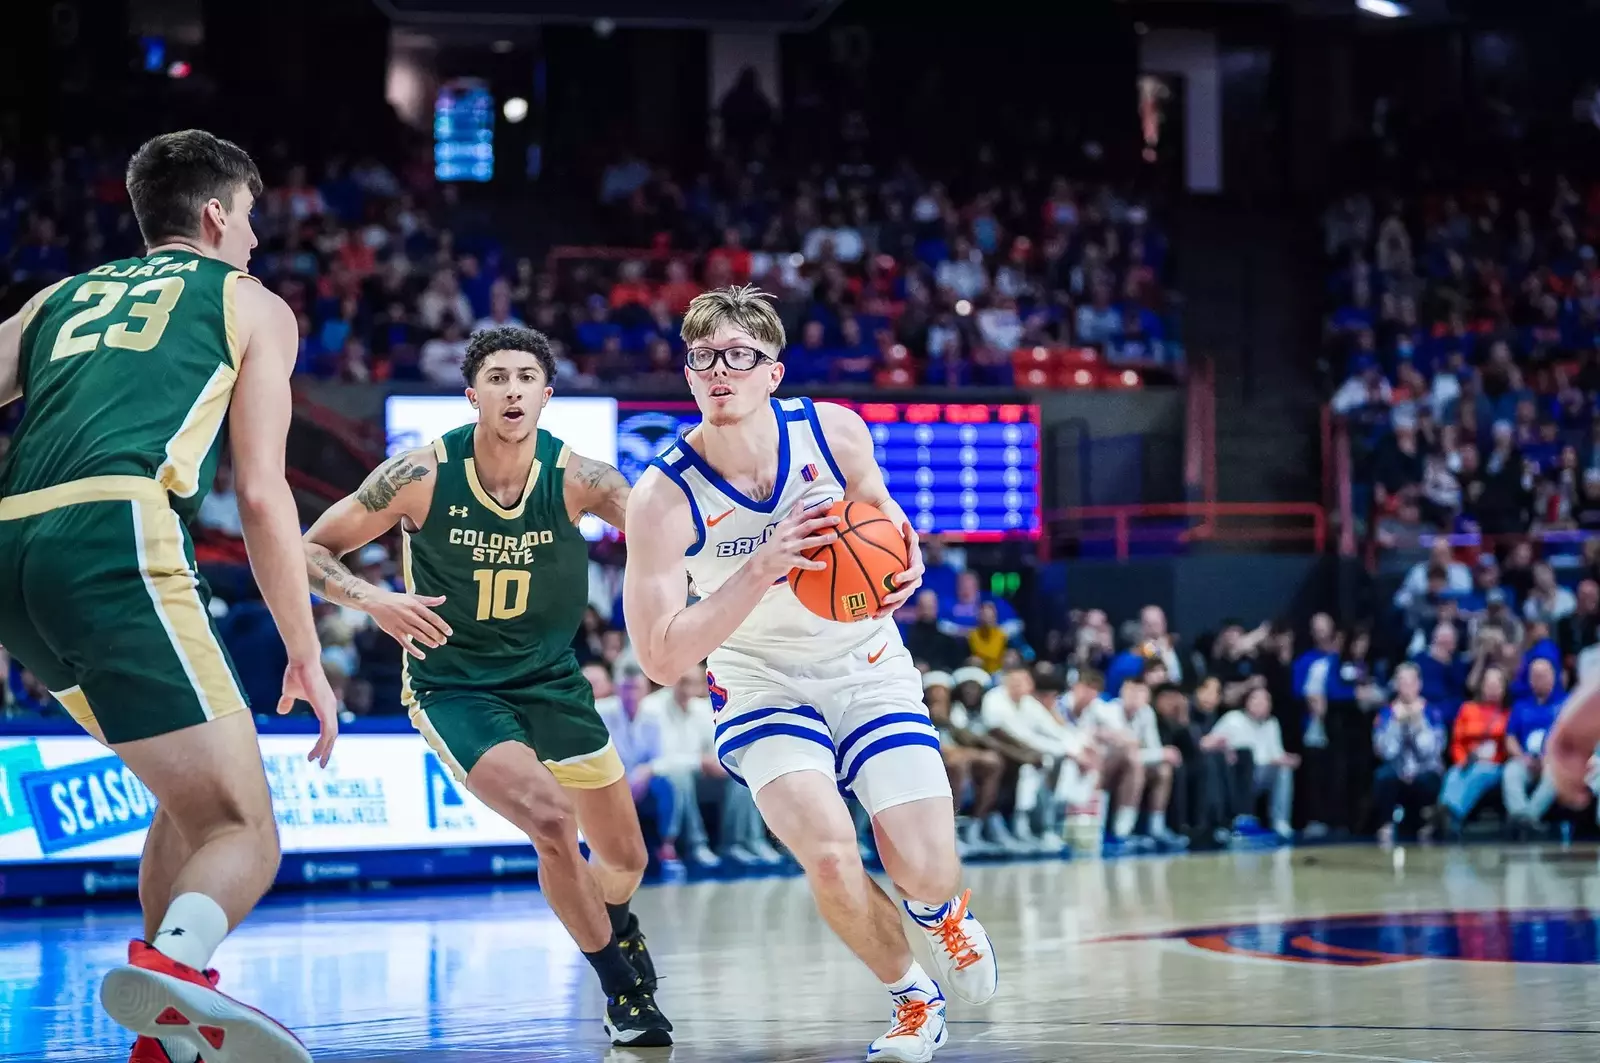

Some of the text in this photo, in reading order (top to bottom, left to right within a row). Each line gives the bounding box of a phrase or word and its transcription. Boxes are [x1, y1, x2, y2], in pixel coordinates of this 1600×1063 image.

[88, 260, 199, 278] DJAPA
[50, 276, 185, 362] 23
[449, 528, 553, 551] COLORADO
[472, 547, 534, 565] STATE
[473, 569, 531, 620] 10
